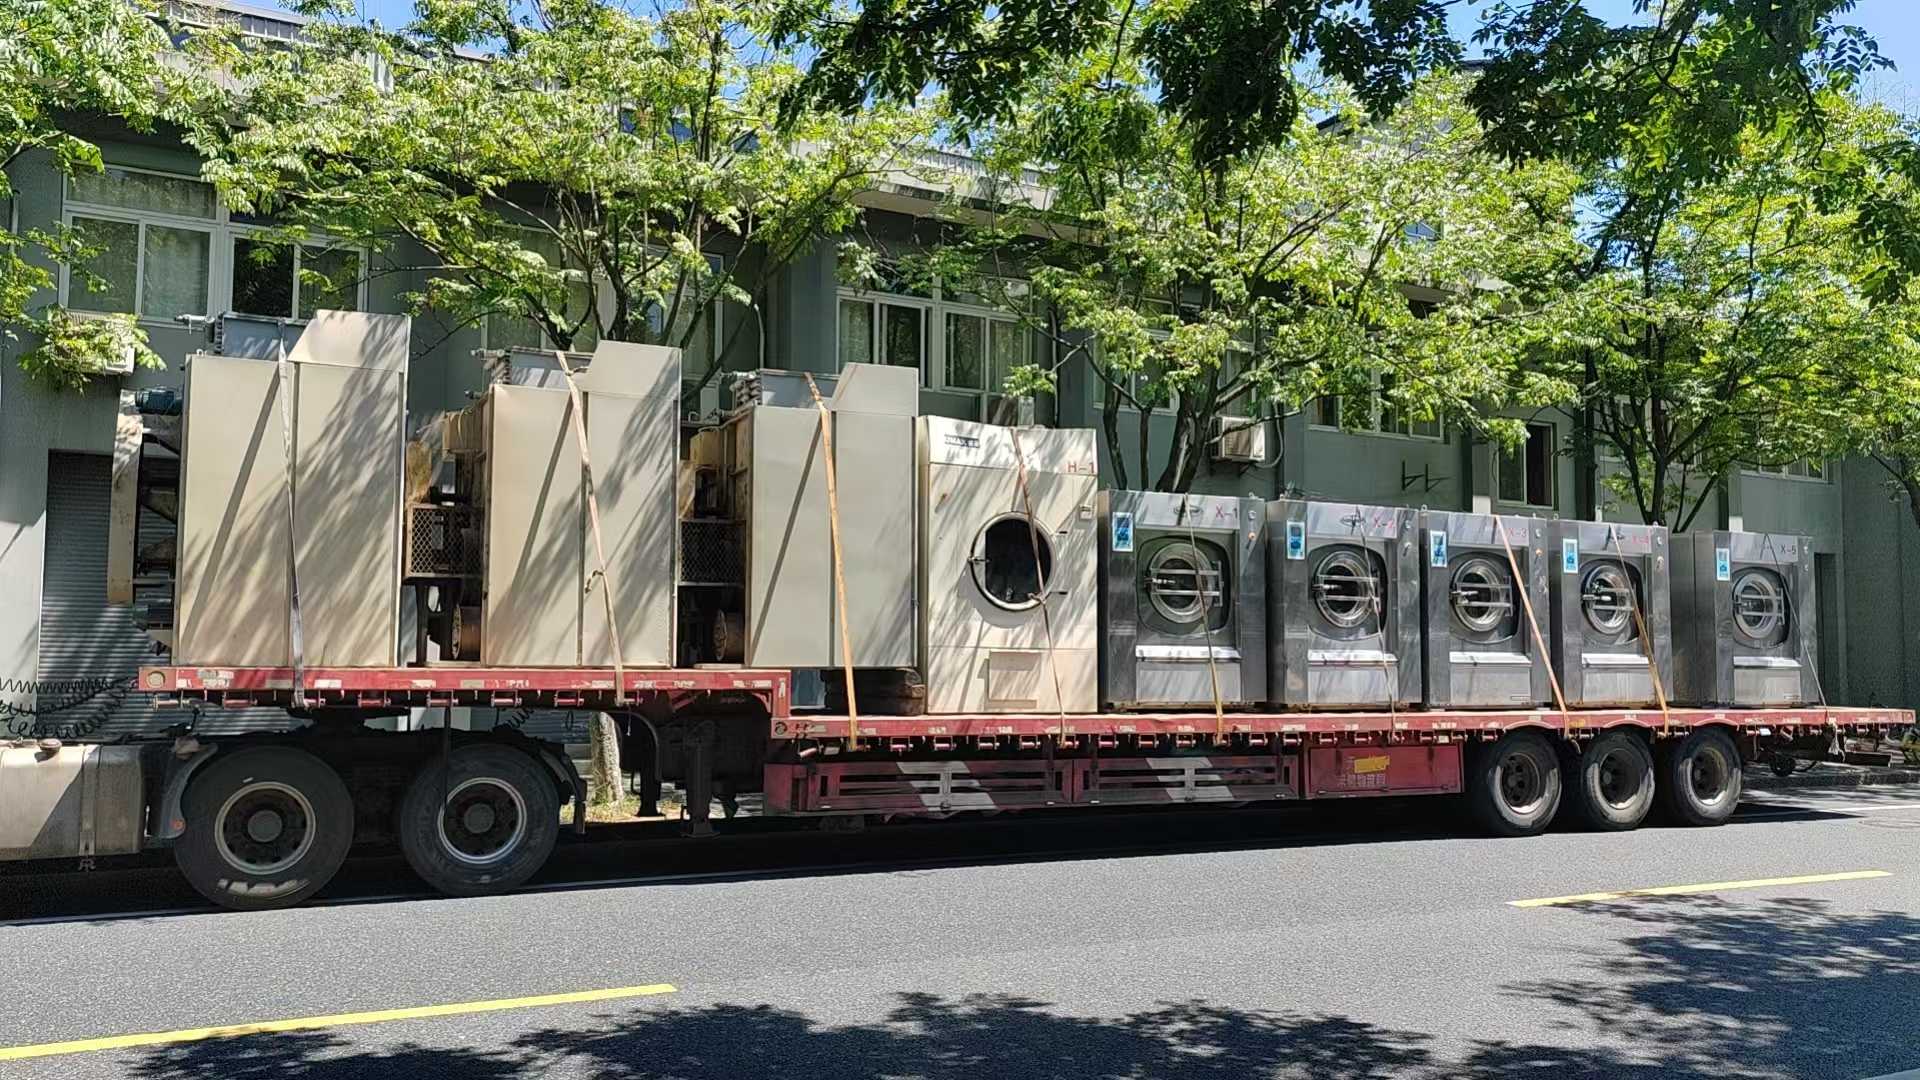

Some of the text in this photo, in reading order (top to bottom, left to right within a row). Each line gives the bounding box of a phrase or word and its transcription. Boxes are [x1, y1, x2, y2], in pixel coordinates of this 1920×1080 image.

[1067, 460, 1095, 474] H-1
[1215, 505, 1238, 519] X-1
[1373, 516, 1396, 529] X-2
[1508, 527, 1528, 538] X-3
[1780, 543, 1797, 555] X-5
